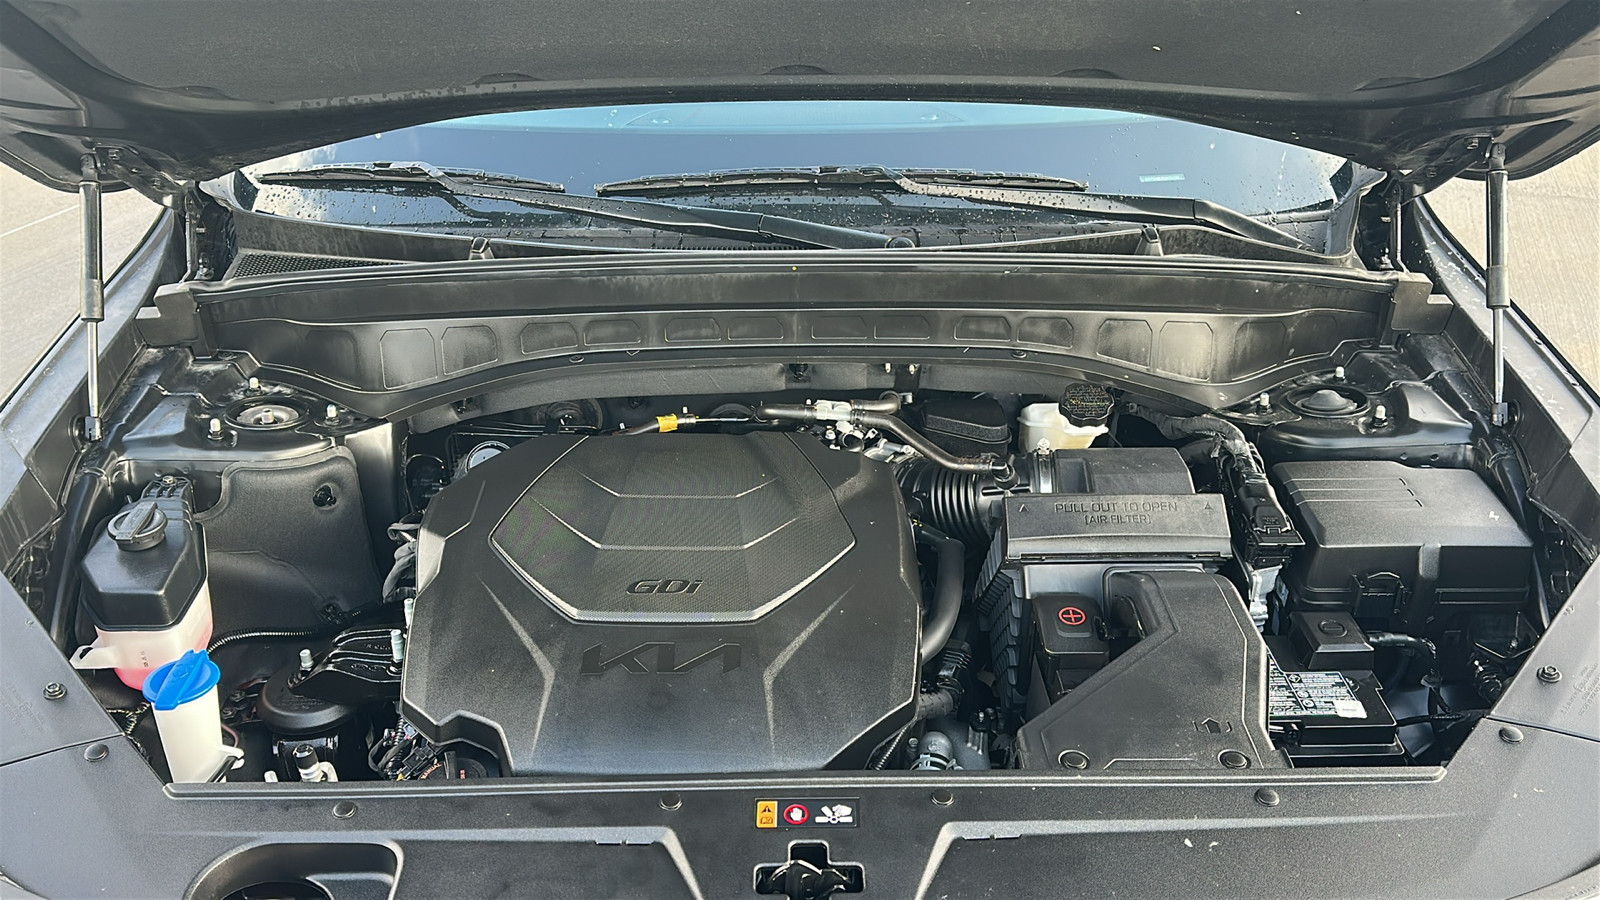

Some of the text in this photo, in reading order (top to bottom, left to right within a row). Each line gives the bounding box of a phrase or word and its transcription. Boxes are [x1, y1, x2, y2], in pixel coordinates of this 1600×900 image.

[1055, 501, 1178, 513] PULL OUT TO OPEN
[626, 579, 704, 595] GDi
